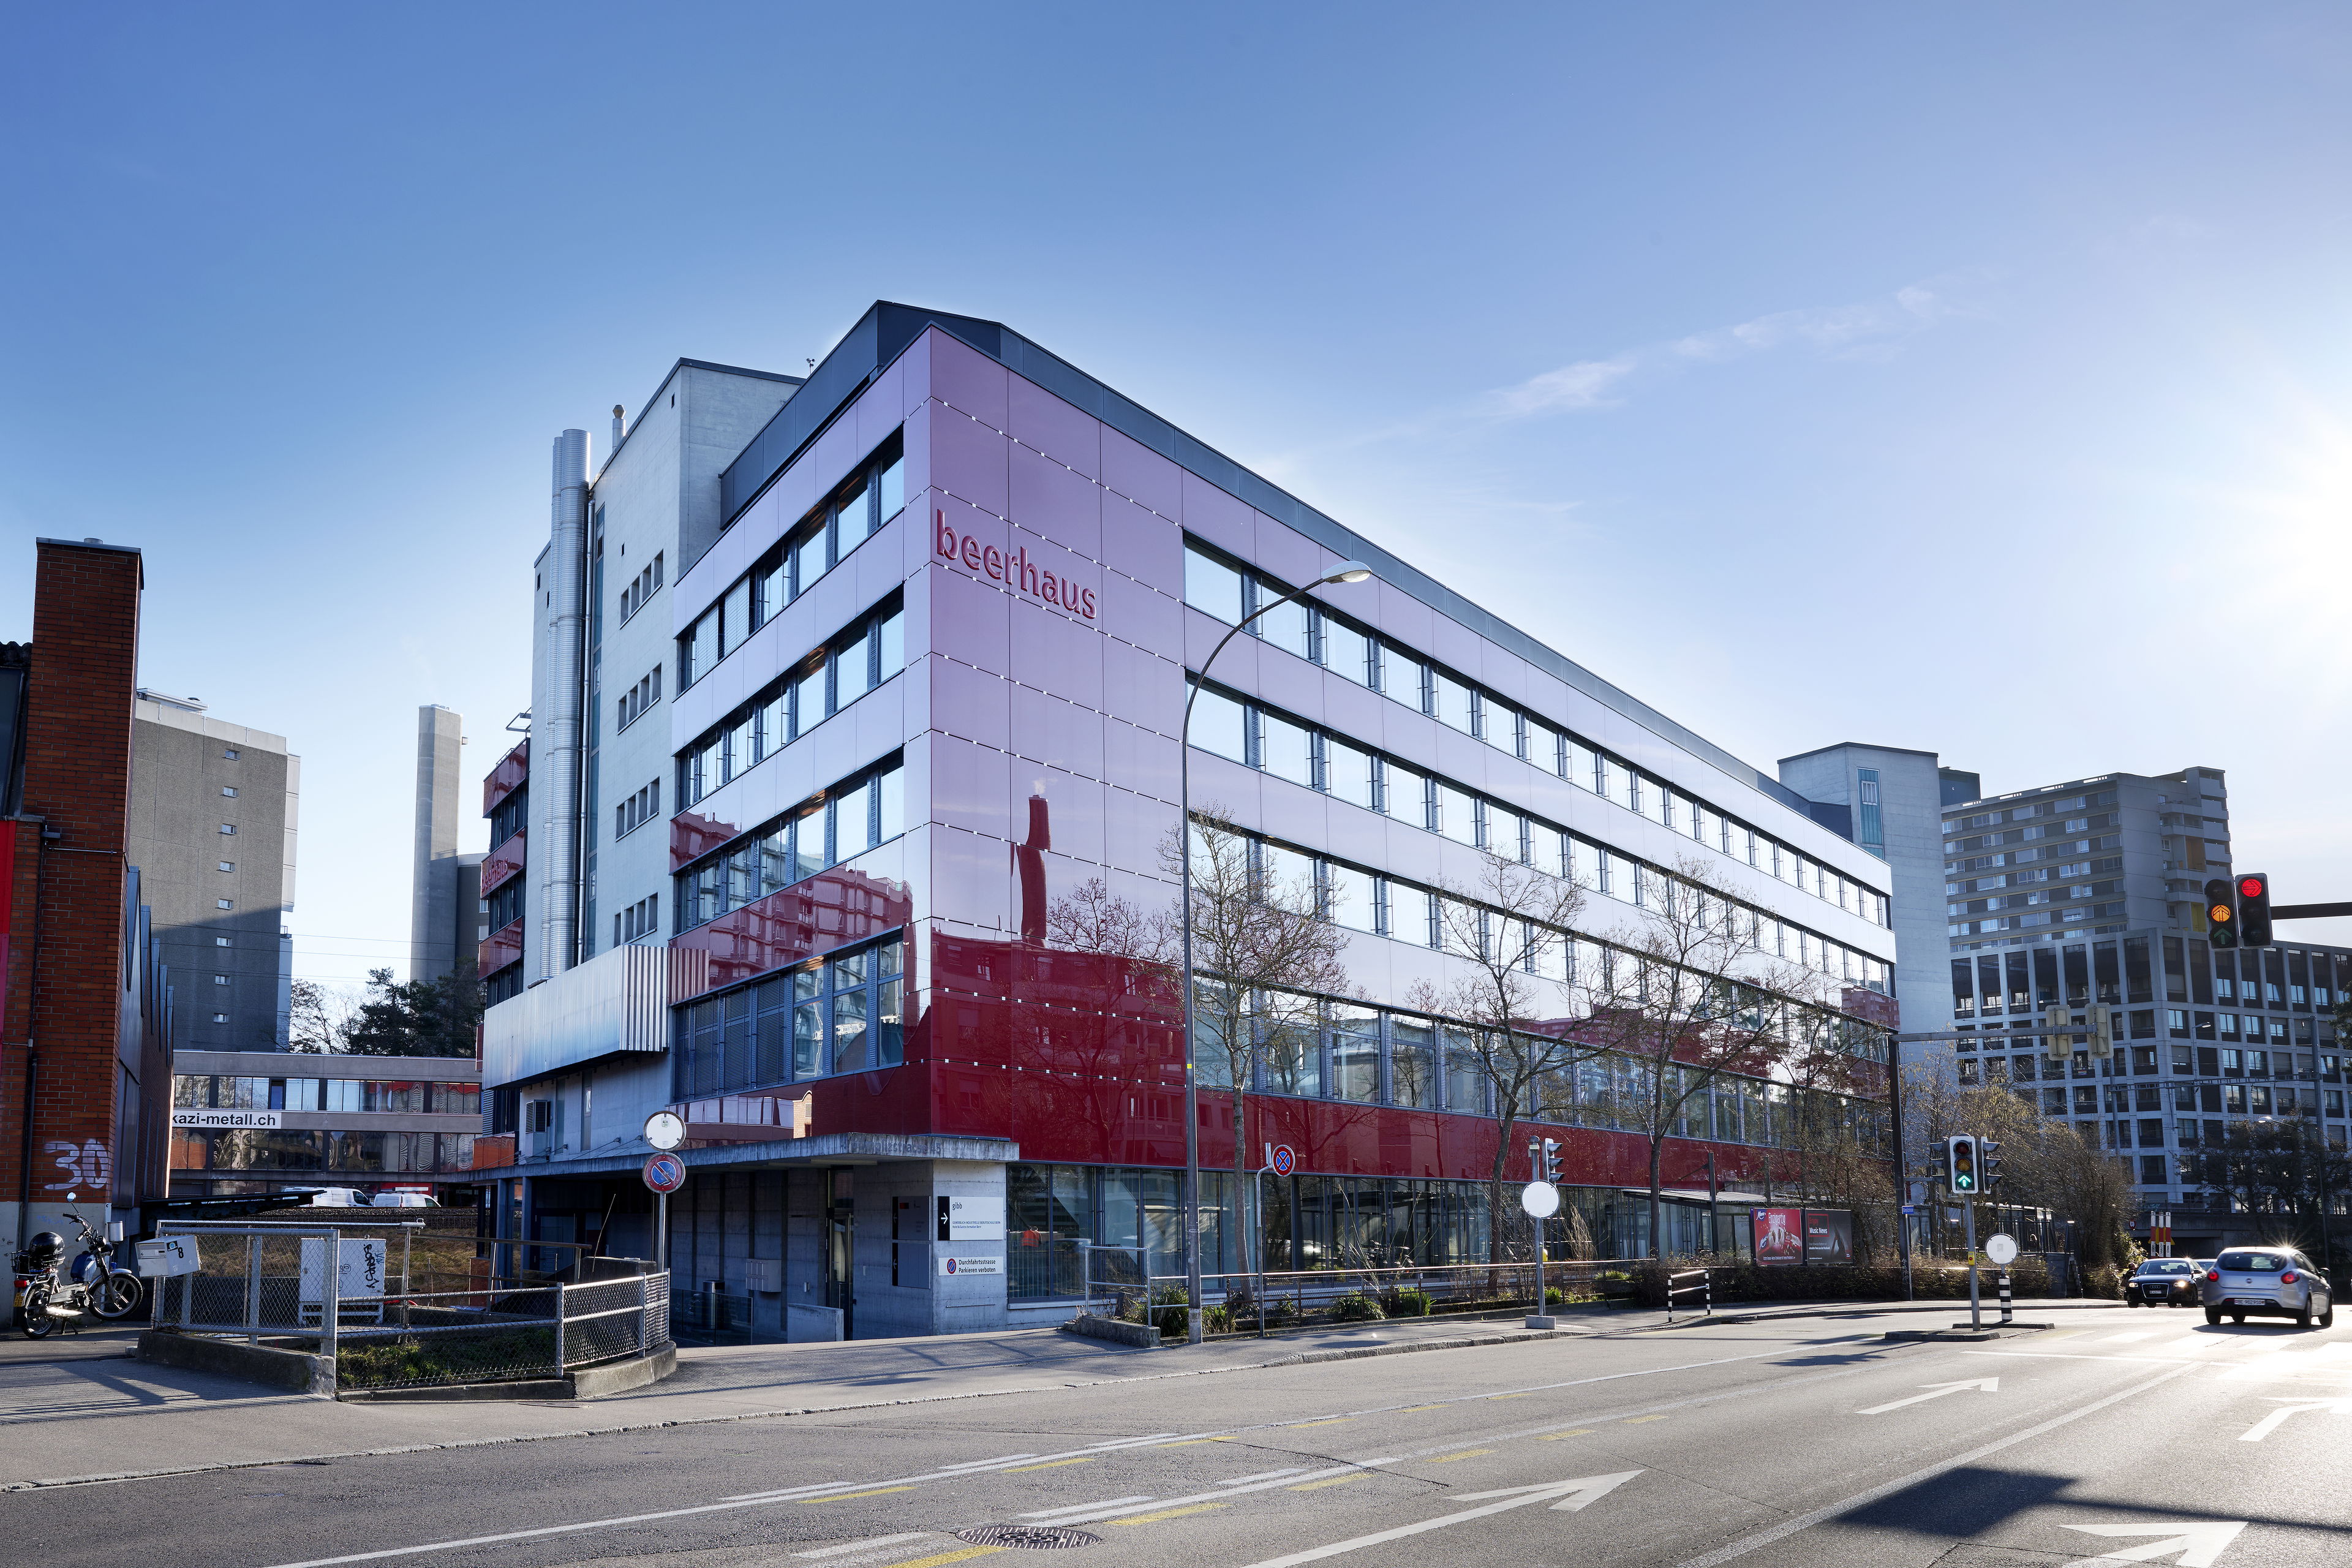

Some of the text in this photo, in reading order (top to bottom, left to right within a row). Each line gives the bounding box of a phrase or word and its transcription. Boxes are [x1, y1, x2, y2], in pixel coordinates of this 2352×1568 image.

[937, 508, 1097, 619] beerhaus
[43, 1139, 108, 1189] 30
[1768, 1212, 1786, 1226] Einzigartig
[178, 1247, 184, 1258] 8
